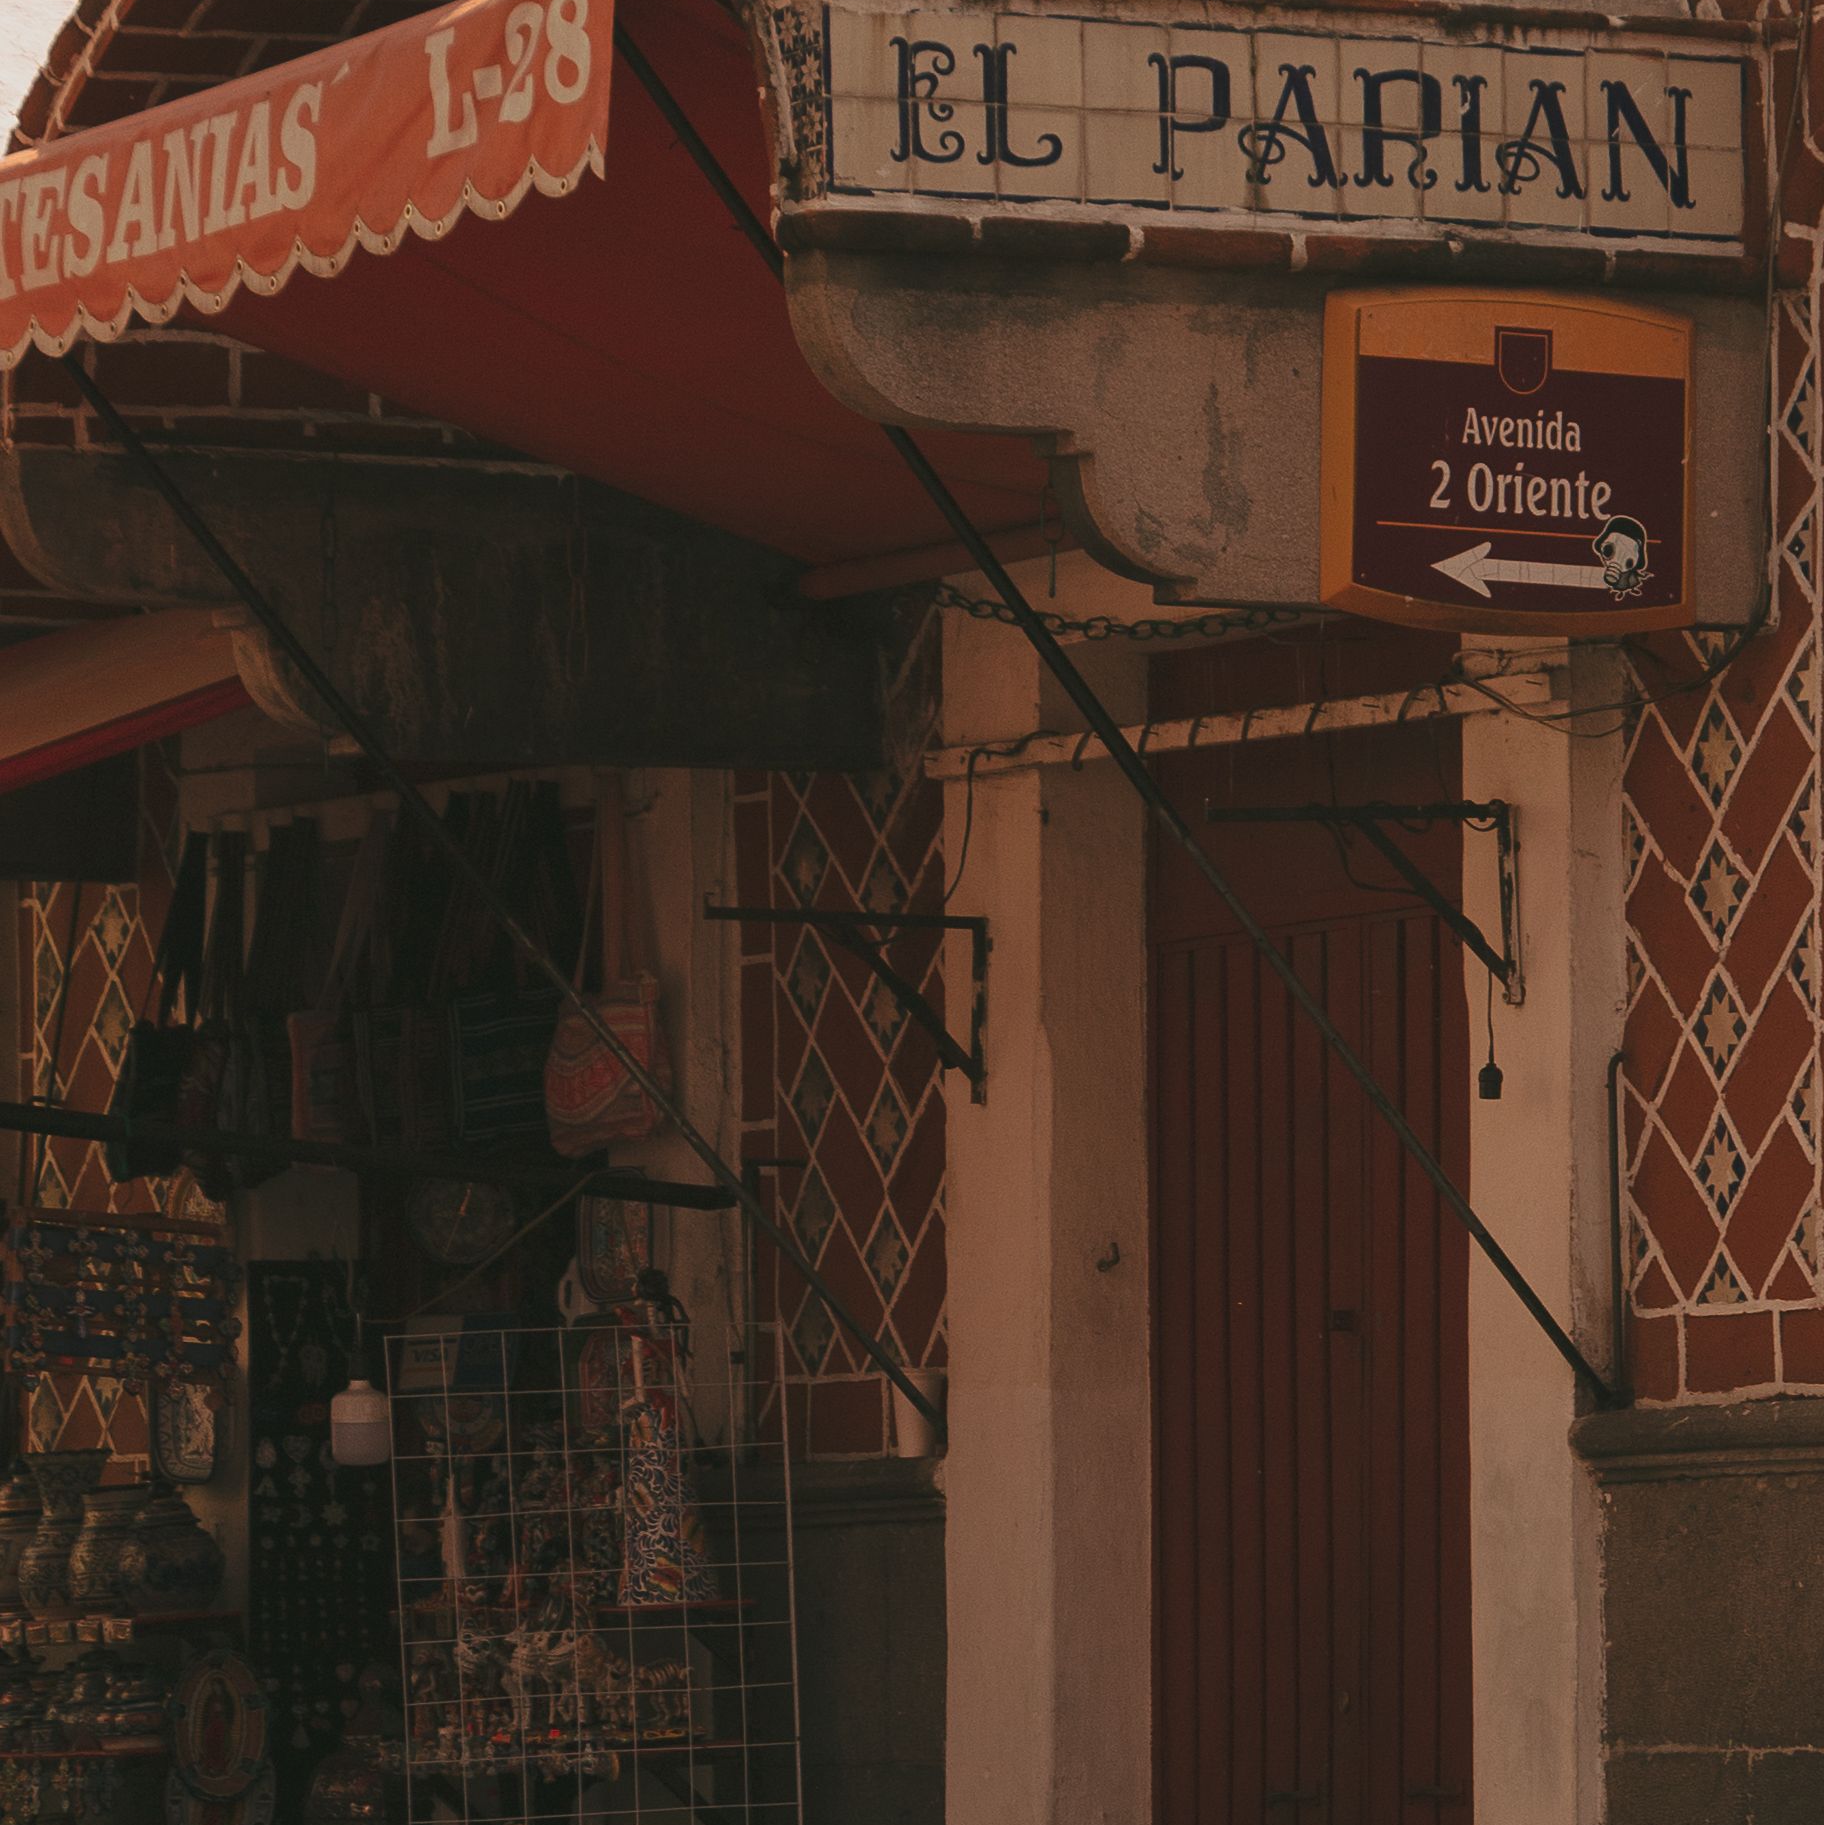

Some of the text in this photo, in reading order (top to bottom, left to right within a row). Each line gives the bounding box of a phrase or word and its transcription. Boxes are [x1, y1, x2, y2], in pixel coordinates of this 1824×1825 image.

[889, 36, 1697, 210] EL PARIAN
[1462, 407, 1582, 453] Avenida
[1429, 459, 1612, 521] 2 Oriente
